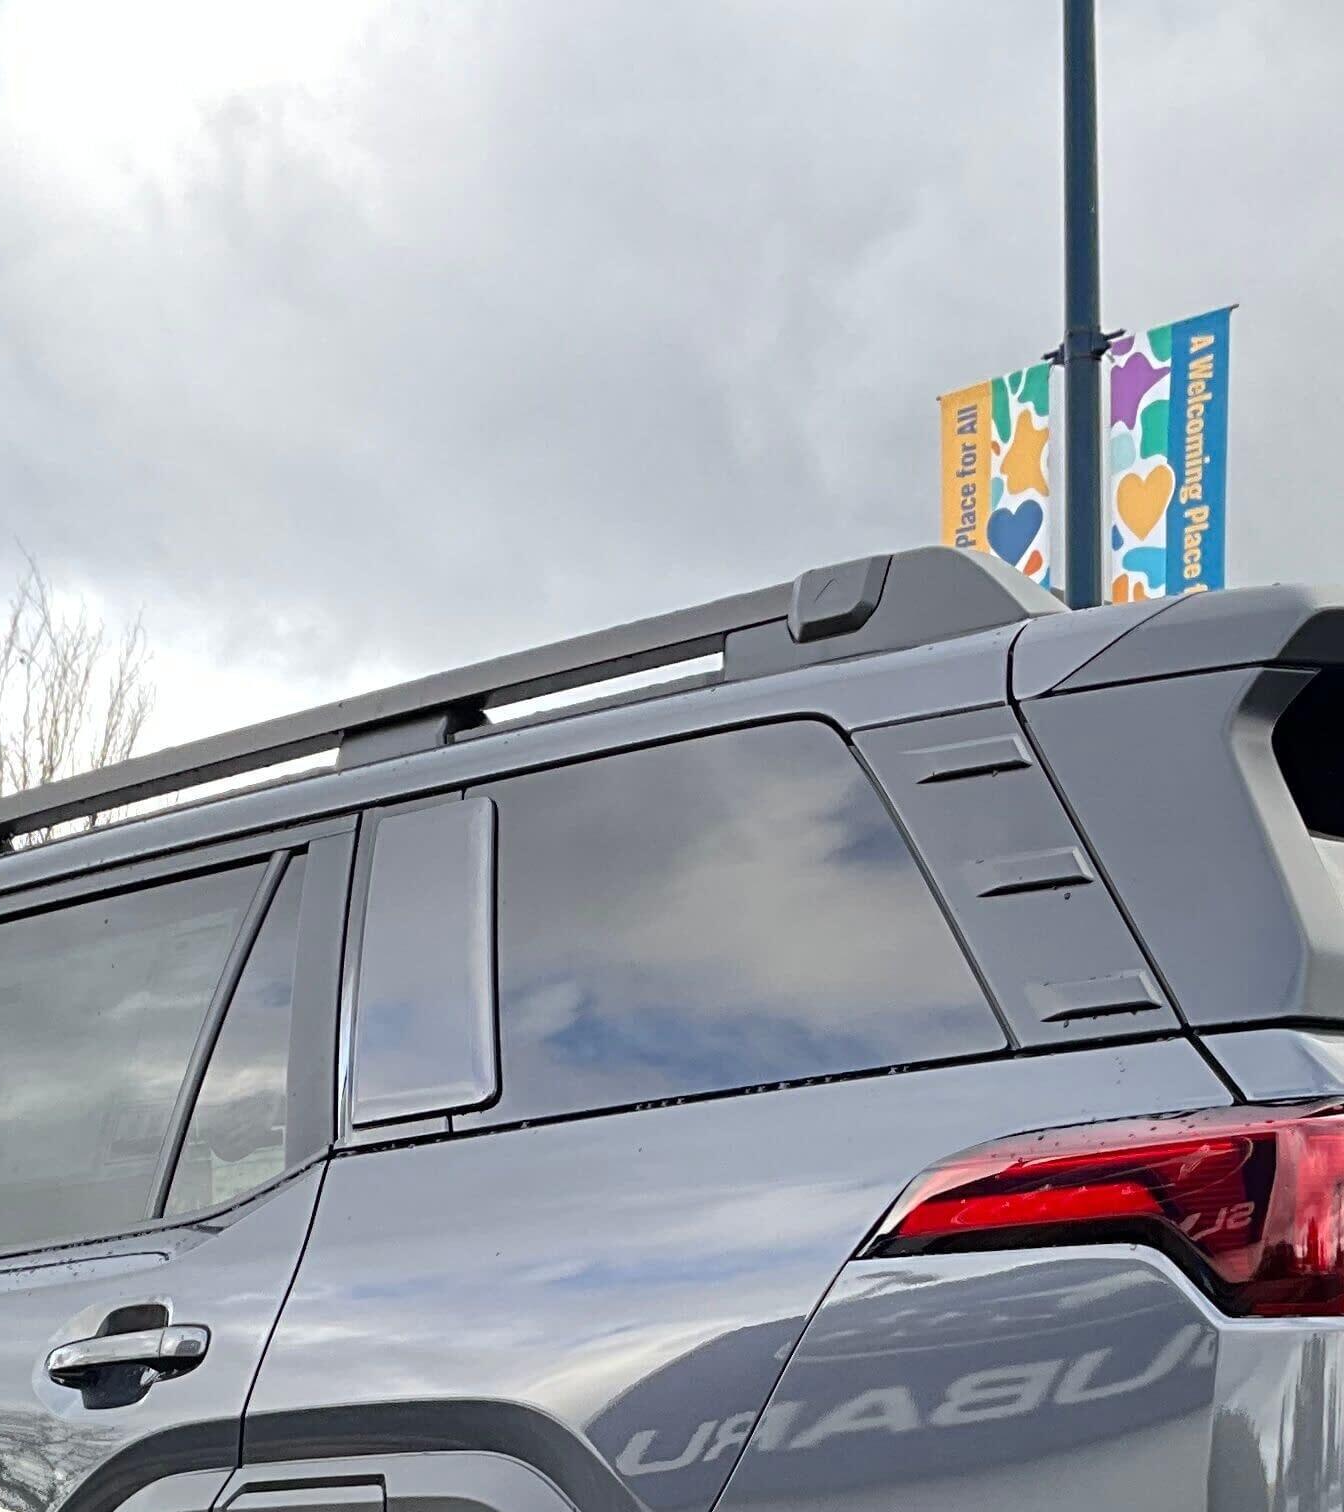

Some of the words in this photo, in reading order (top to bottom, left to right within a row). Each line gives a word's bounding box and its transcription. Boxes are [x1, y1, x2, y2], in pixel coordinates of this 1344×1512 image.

[1189, 334, 1214, 353] A
[957, 404, 978, 435] All
[1180, 354, 1214, 503] Welcoming
[956, 443, 977, 478] for
[955, 483, 977, 548] Place
[1183, 505, 1210, 579] Place
